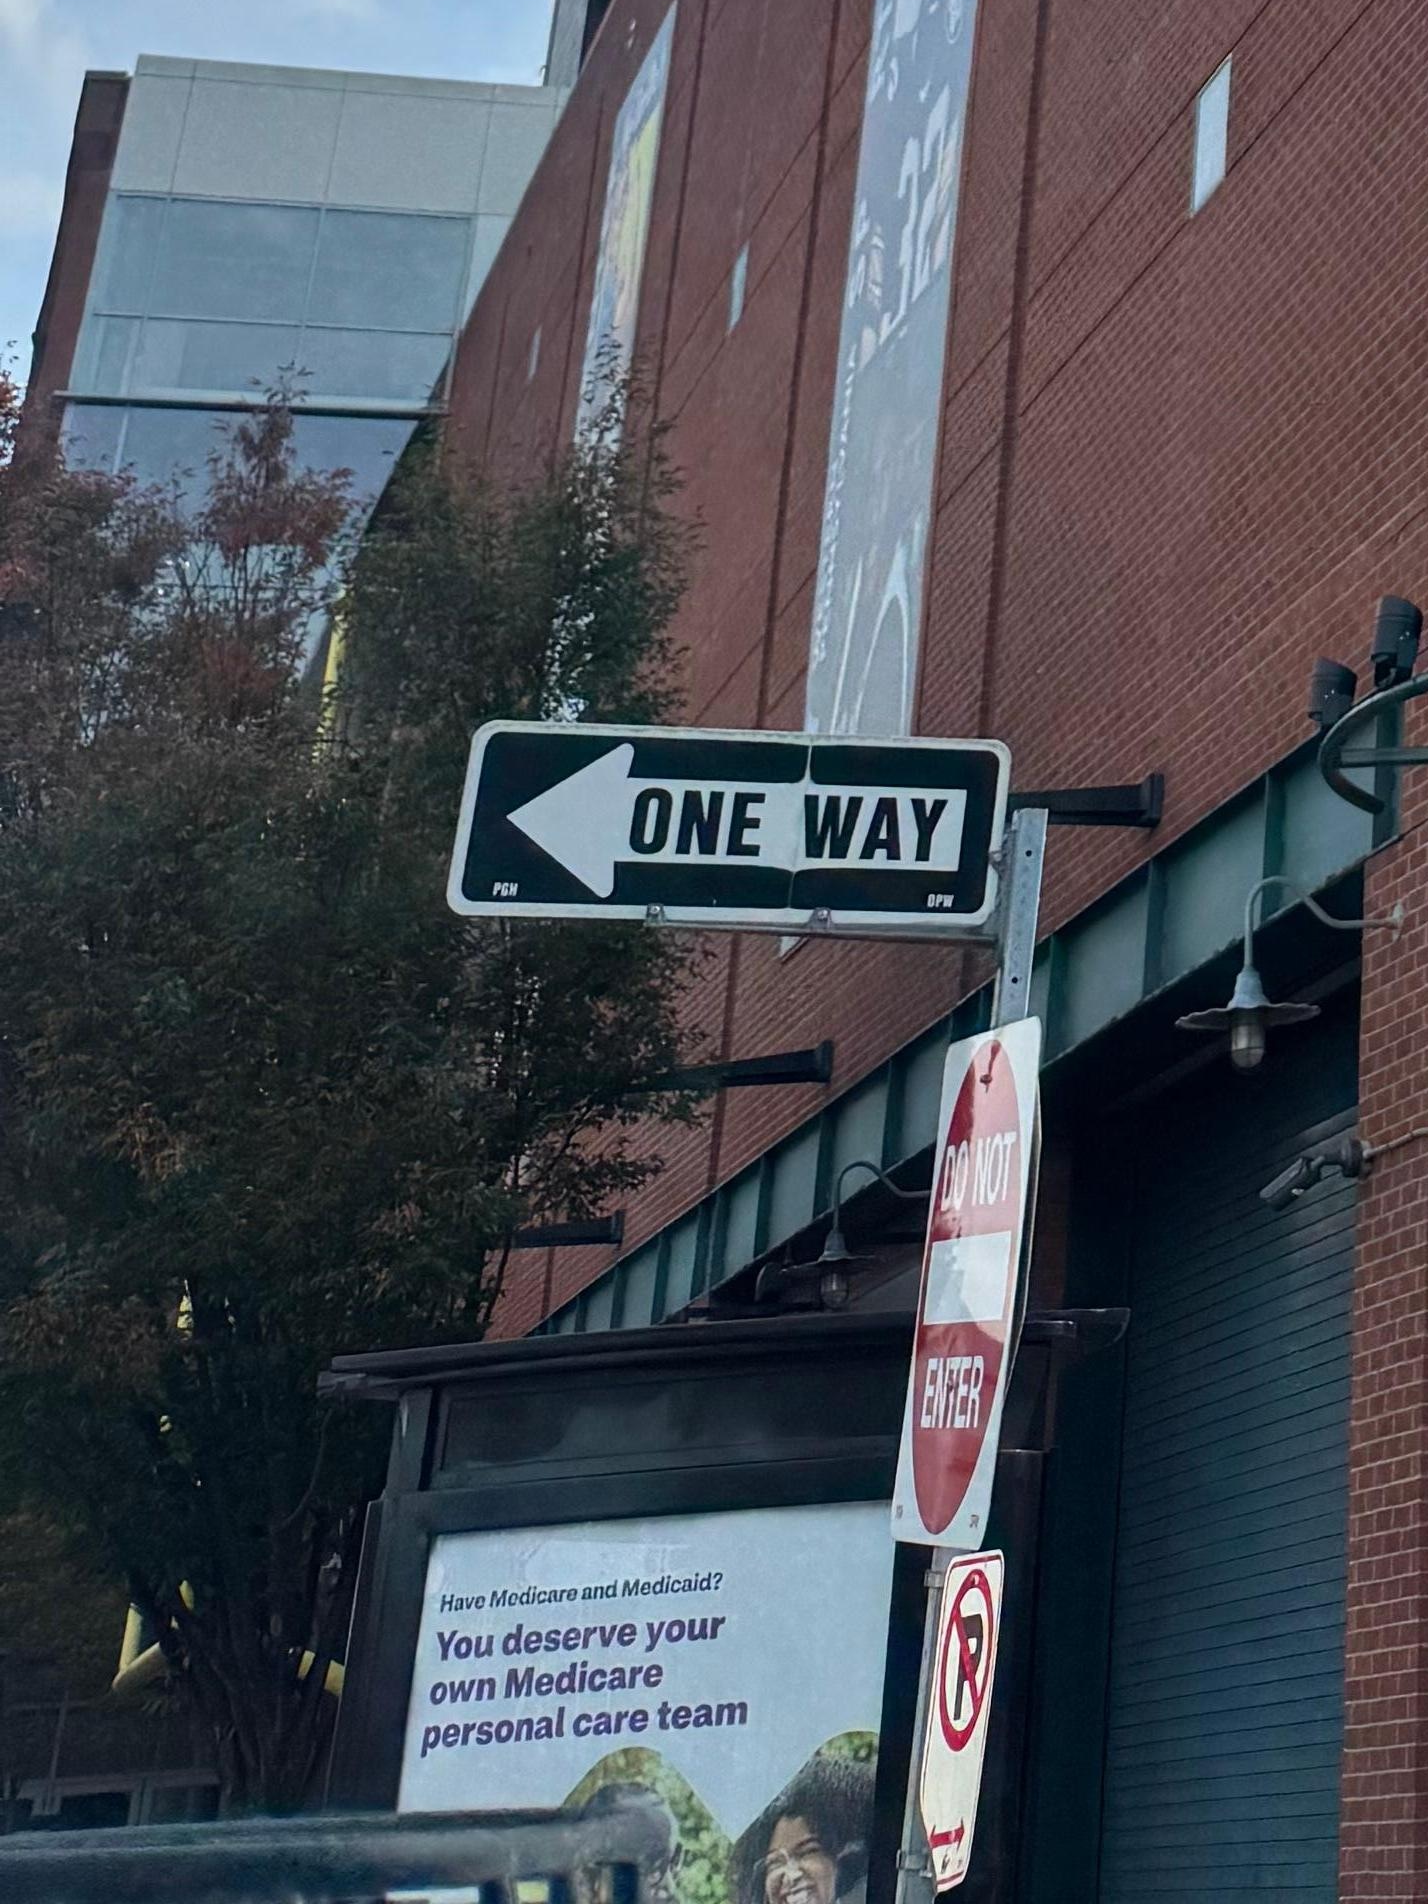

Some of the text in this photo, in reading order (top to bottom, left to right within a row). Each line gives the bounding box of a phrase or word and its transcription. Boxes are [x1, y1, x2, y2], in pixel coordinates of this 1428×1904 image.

[628, 788, 949, 862] ONE WAY
[493, 882, 518, 896] PGH
[941, 1131, 1018, 1212] DO NOT
[920, 1356, 984, 1429] ENTER
[440, 1572, 723, 1613] Have Medicare and Medicaid?
[437, 1616, 726, 1661] You deserve your
[429, 1661, 663, 1705] own Medicare
[421, 1701, 748, 1758] personal care team
